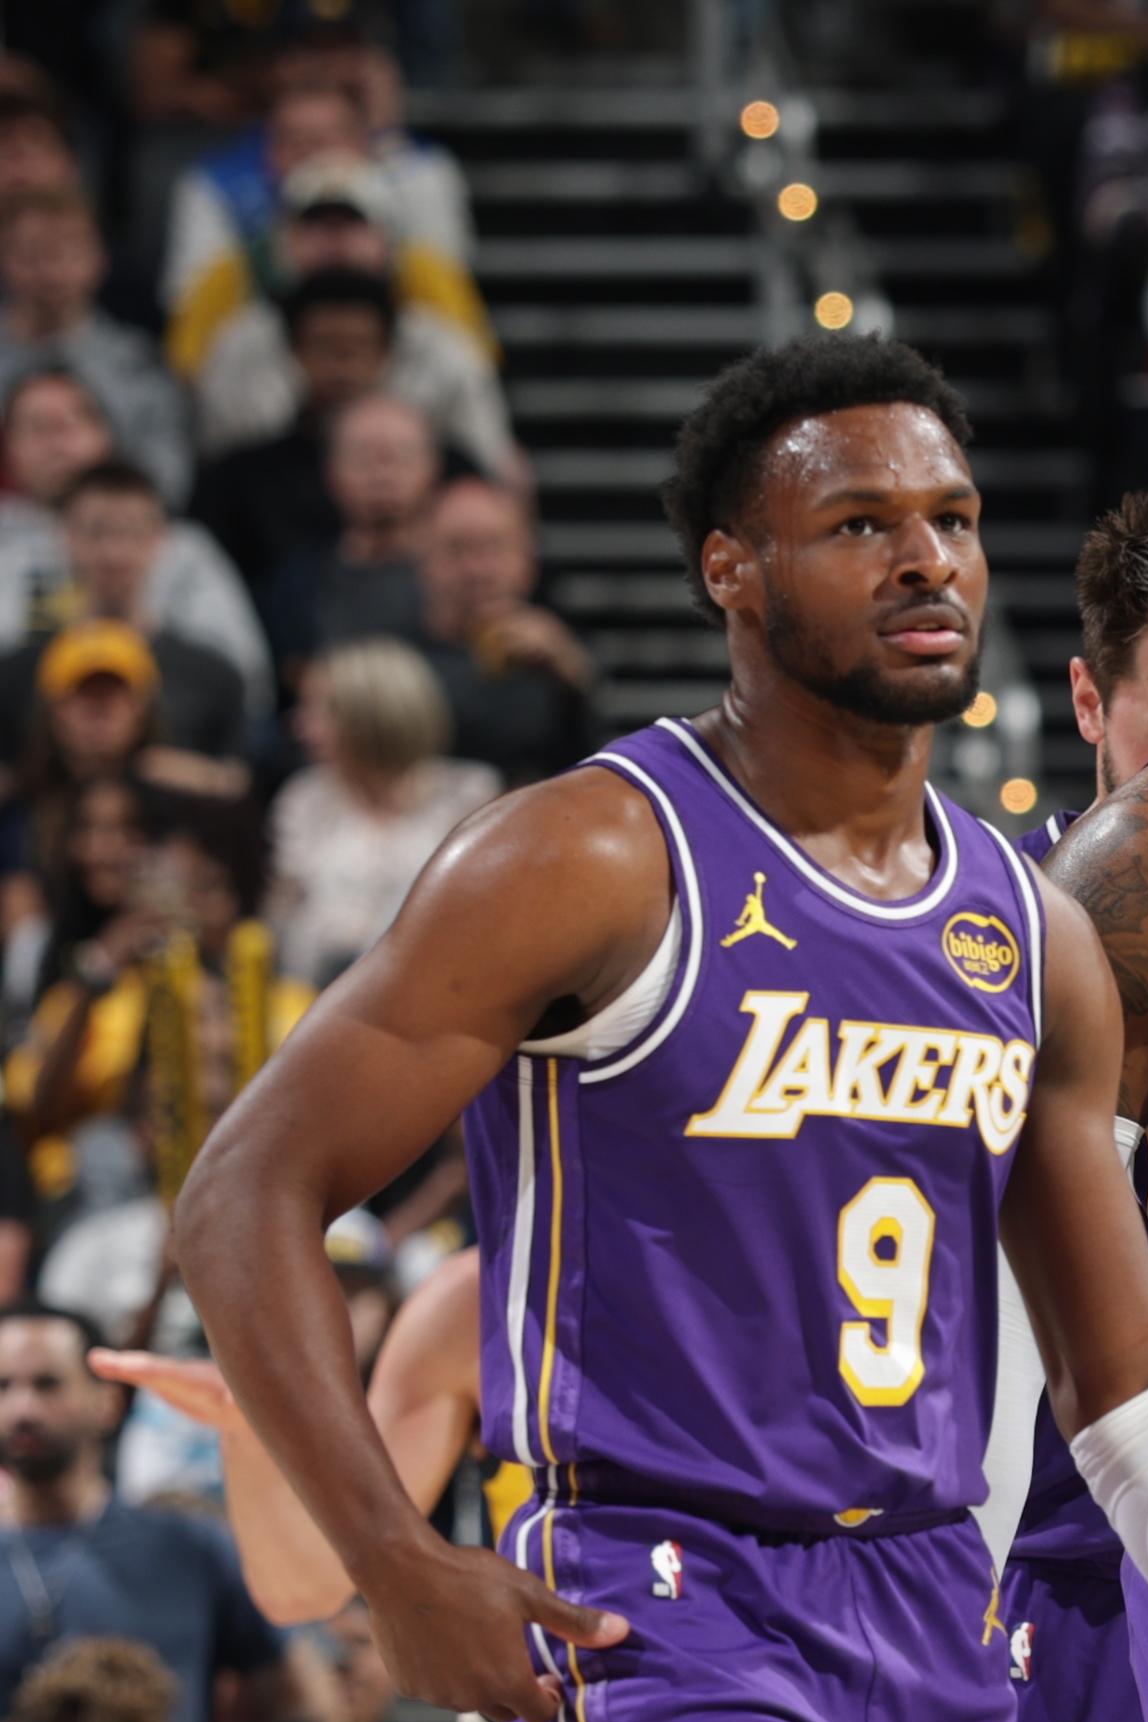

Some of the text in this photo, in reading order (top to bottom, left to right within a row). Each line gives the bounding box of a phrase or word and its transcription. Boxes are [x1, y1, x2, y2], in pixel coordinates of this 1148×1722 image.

[949, 931, 1013, 972] bibigo
[684, 990, 1036, 1155] LAKERS
[837, 1177, 936, 1407] 9
